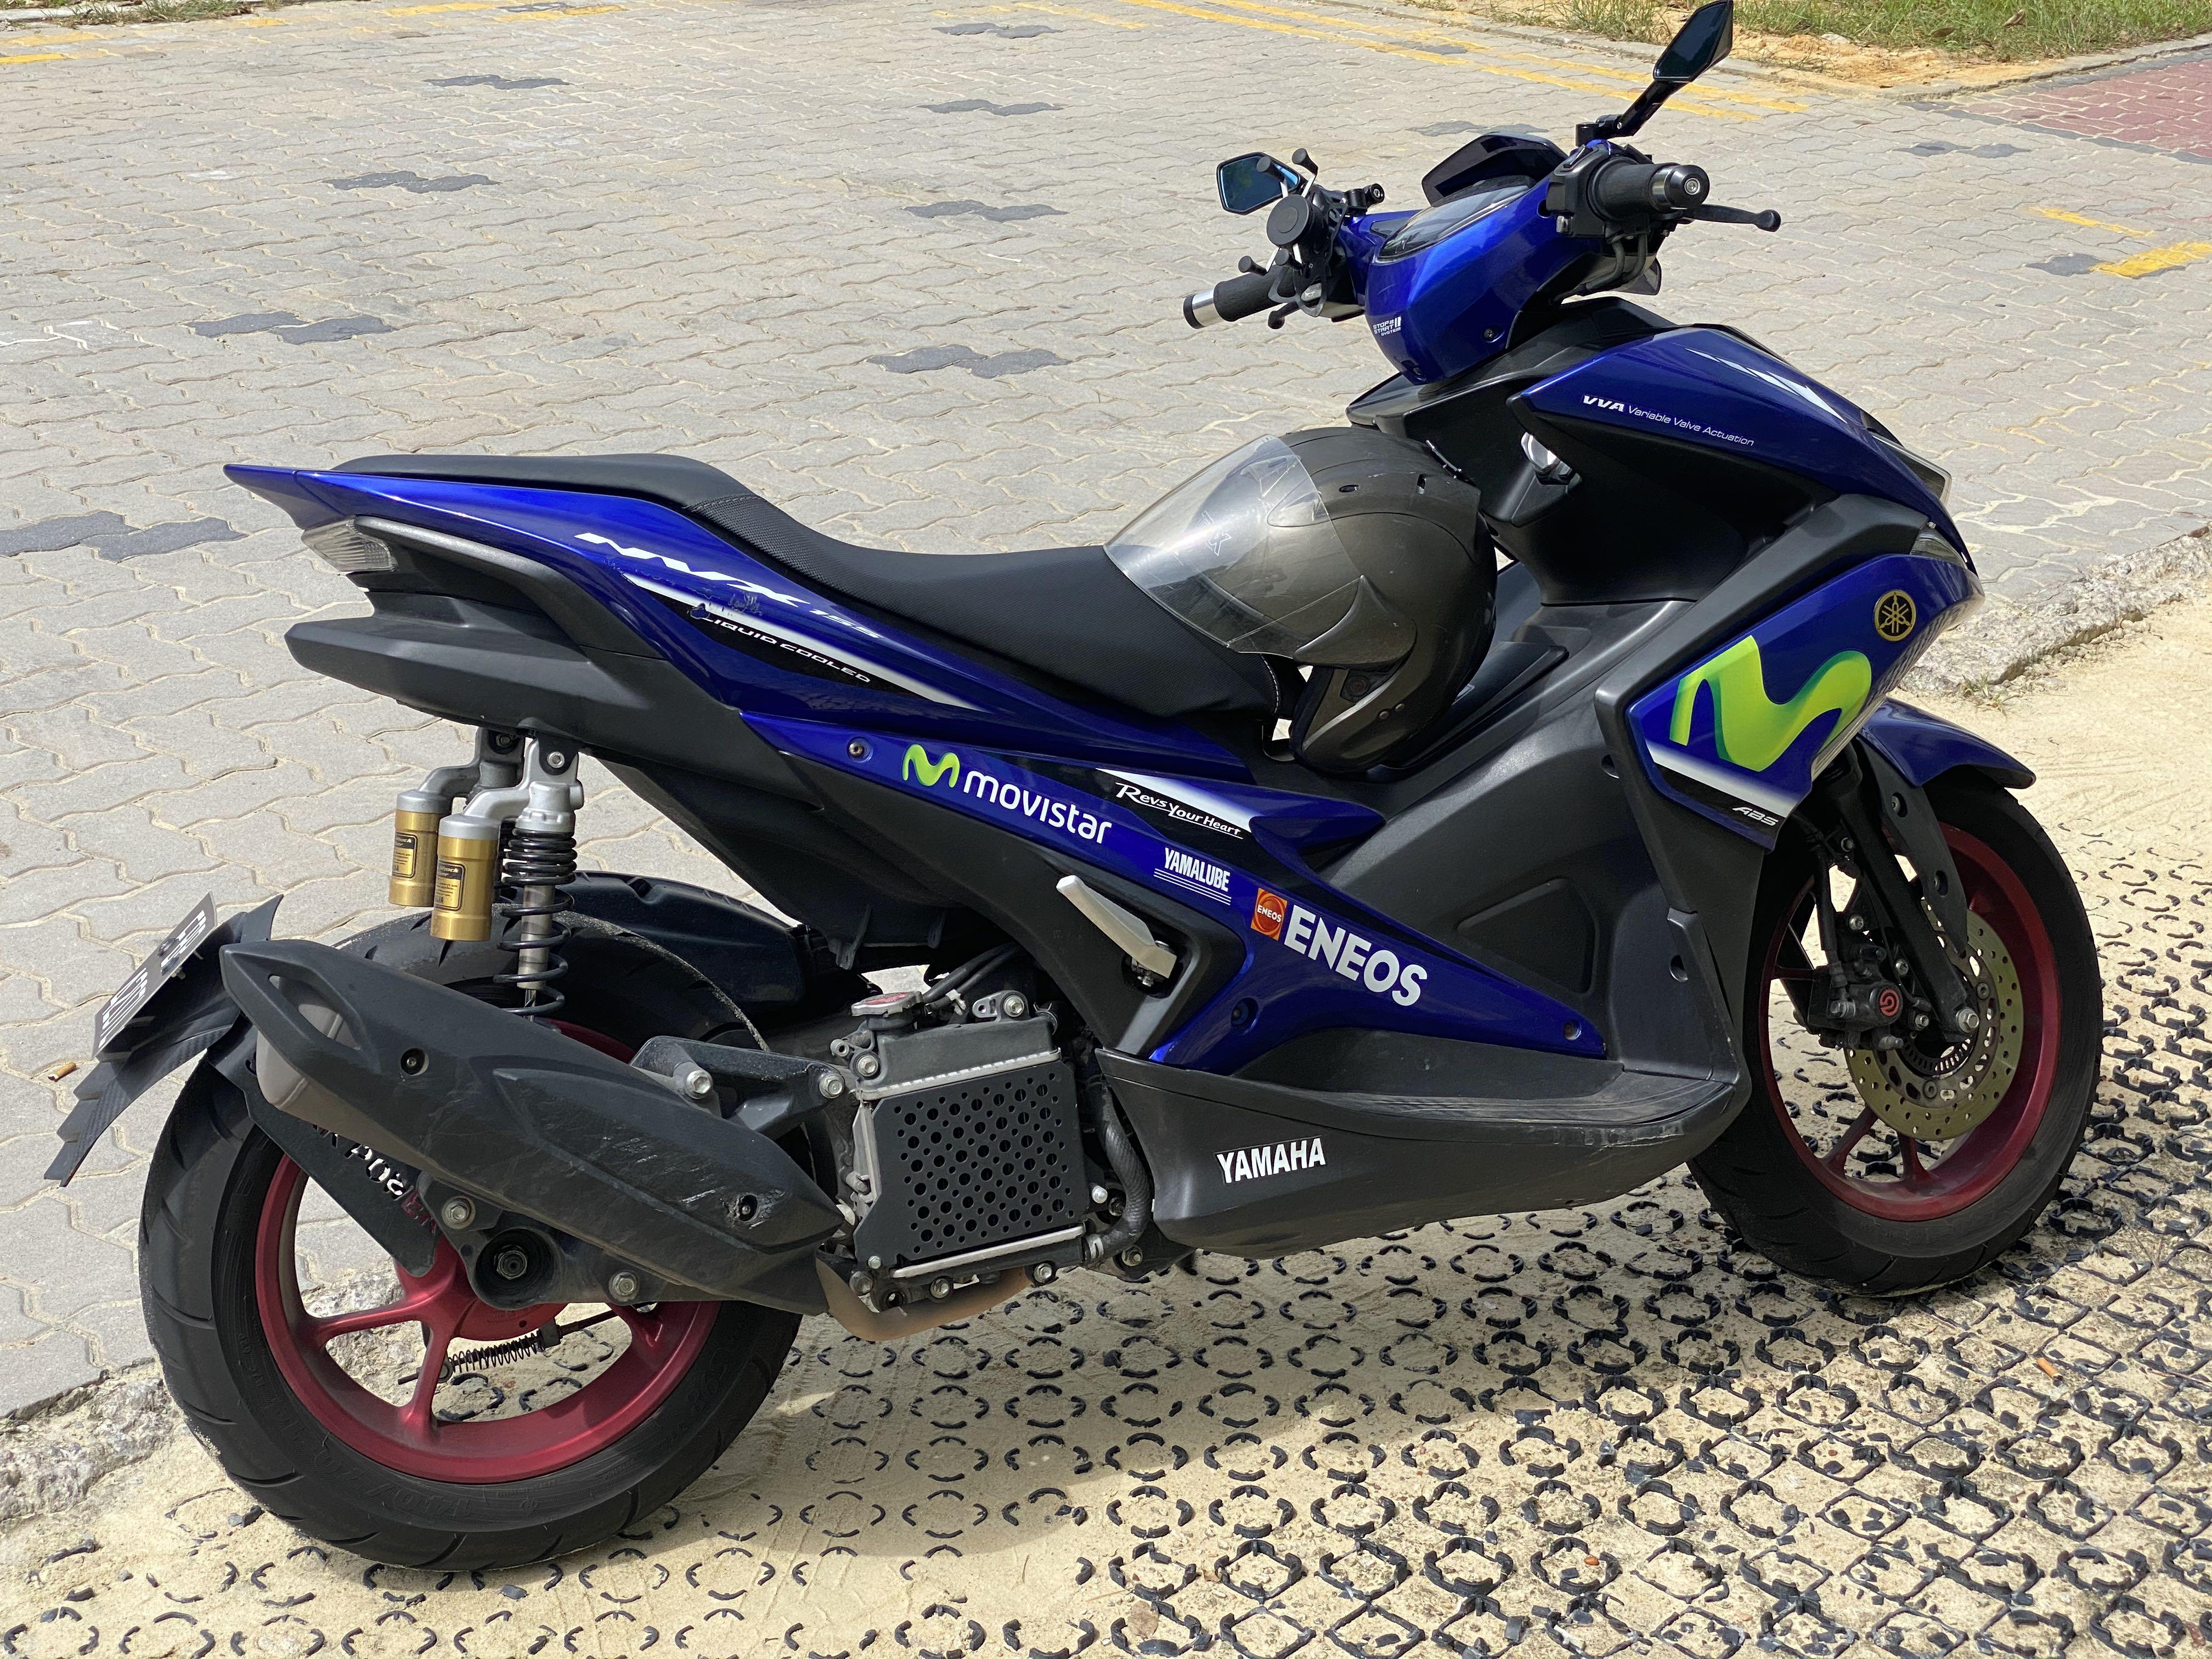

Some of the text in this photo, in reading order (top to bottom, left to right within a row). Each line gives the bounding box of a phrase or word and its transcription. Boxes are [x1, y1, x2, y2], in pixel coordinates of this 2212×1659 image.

[1373, 324, 1394, 335] START
[1380, 326, 1401, 336] SYSTEM
[1583, 394, 1754, 447] VVA Variable Valve Actuation
[809, 608, 884, 639] 155
[701, 616, 871, 684] LIQUID COOLED
[963, 770, 1113, 844] movistar
[1115, 781, 1242, 836] Revs Your Heart
[1731, 806, 1779, 826] ABS
[1164, 847, 1231, 893] YAMALUBE
[1256, 904, 1283, 923] ENEOS
[1283, 904, 1428, 1007] ENEOS
[1216, 1137, 1327, 1184] YAMAHA
